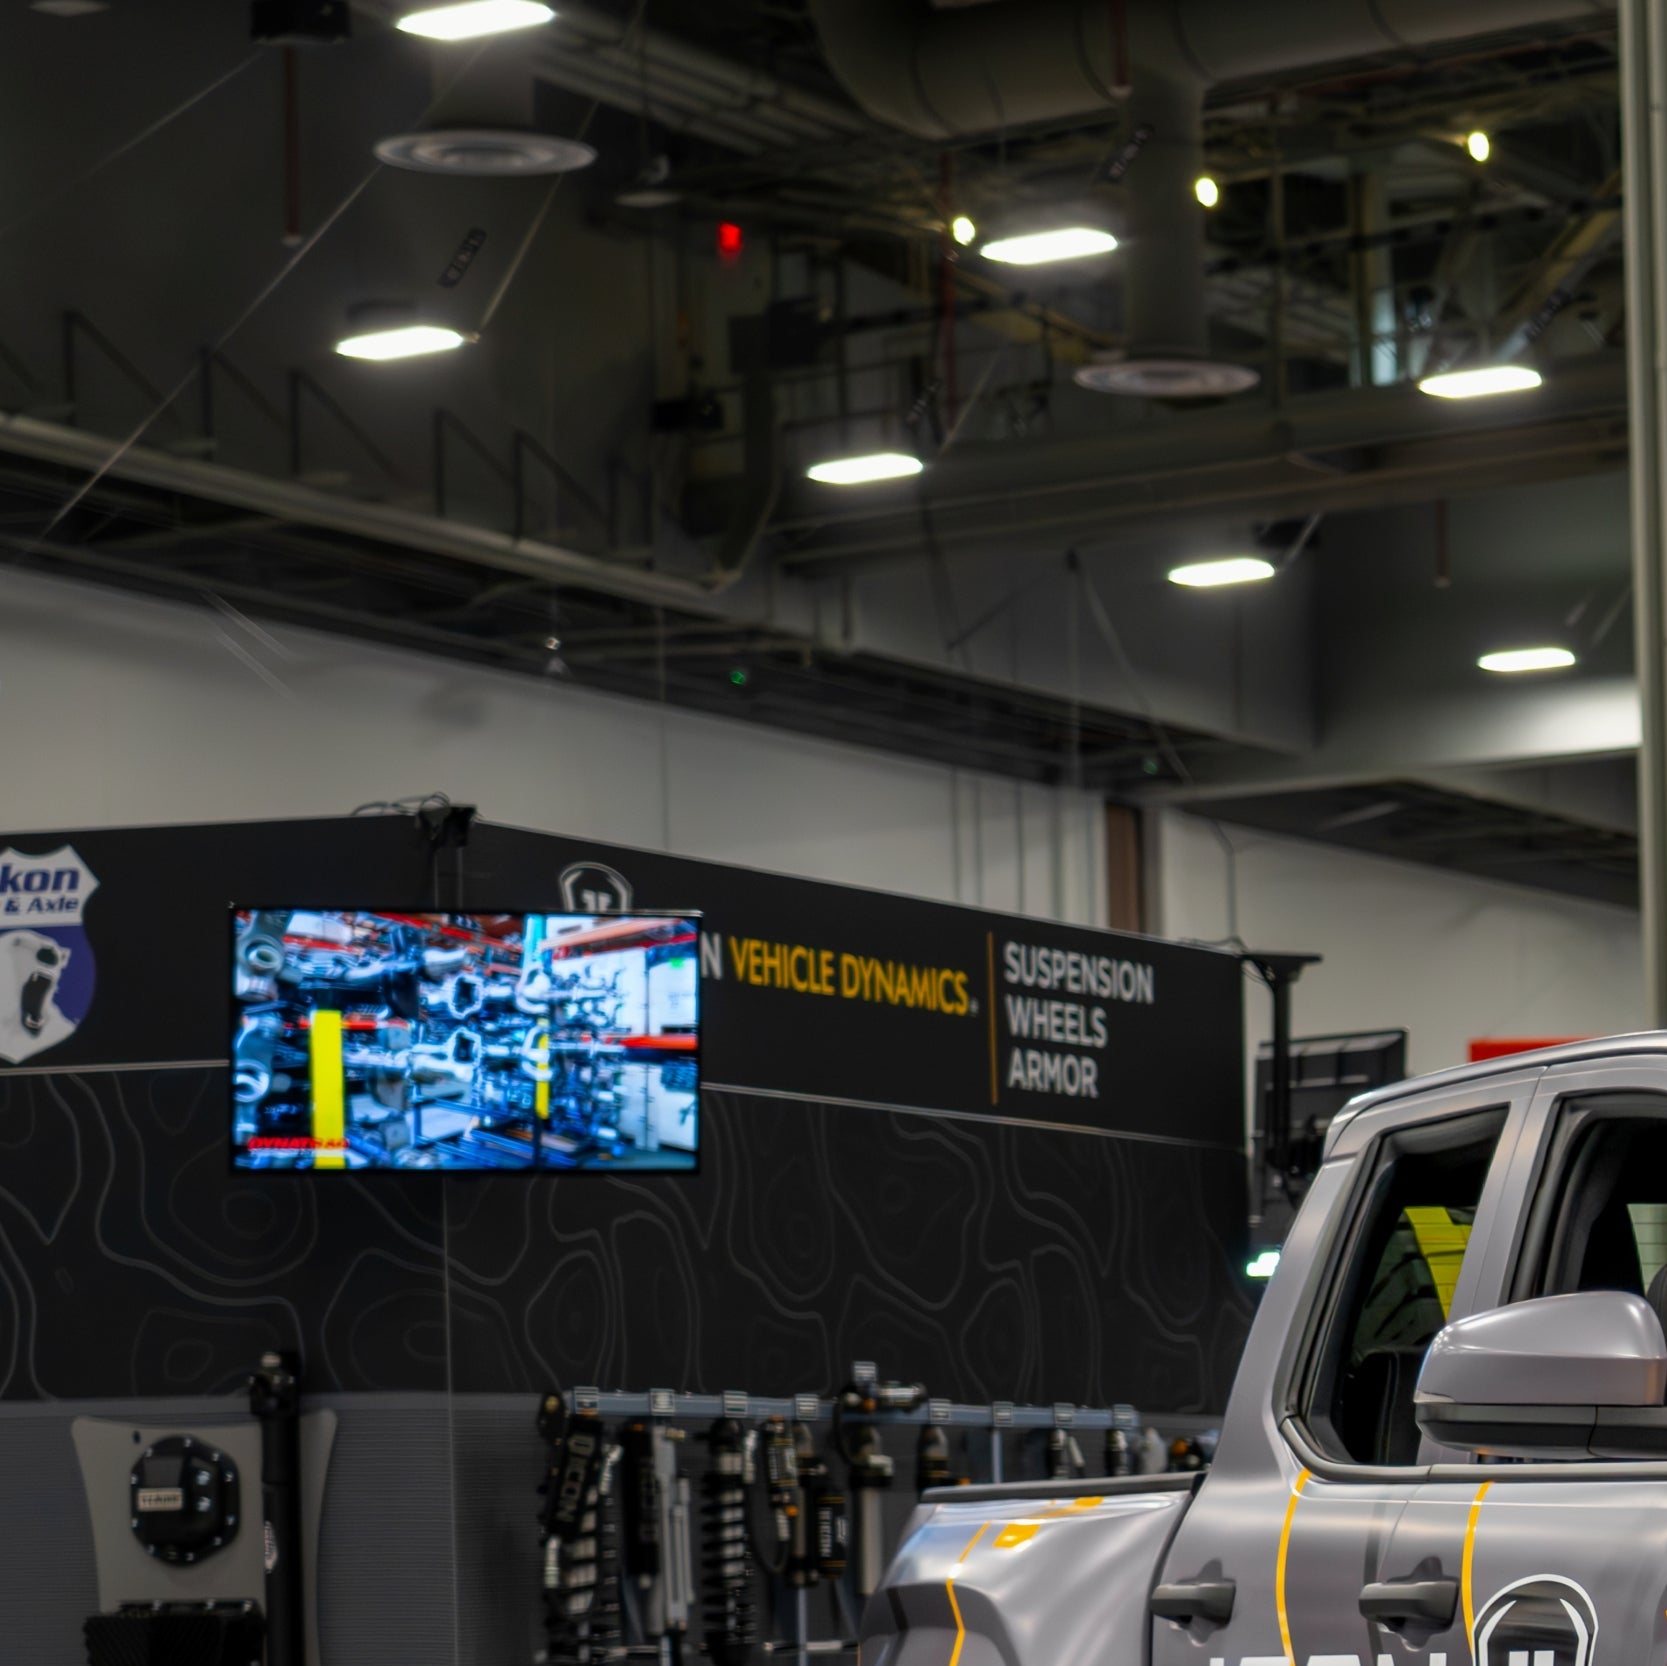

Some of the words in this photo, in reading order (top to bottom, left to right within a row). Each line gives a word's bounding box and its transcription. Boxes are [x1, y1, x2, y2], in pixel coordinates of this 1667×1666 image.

[27, 896, 79, 914] Axle
[729, 935, 836, 998] VEHICLE
[841, 954, 971, 1018] DYNAMICS
[1004, 941, 1156, 1004] SUSPENSION
[1006, 994, 1108, 1048] WHEELS
[1007, 1049, 1099, 1099] ARMOR
